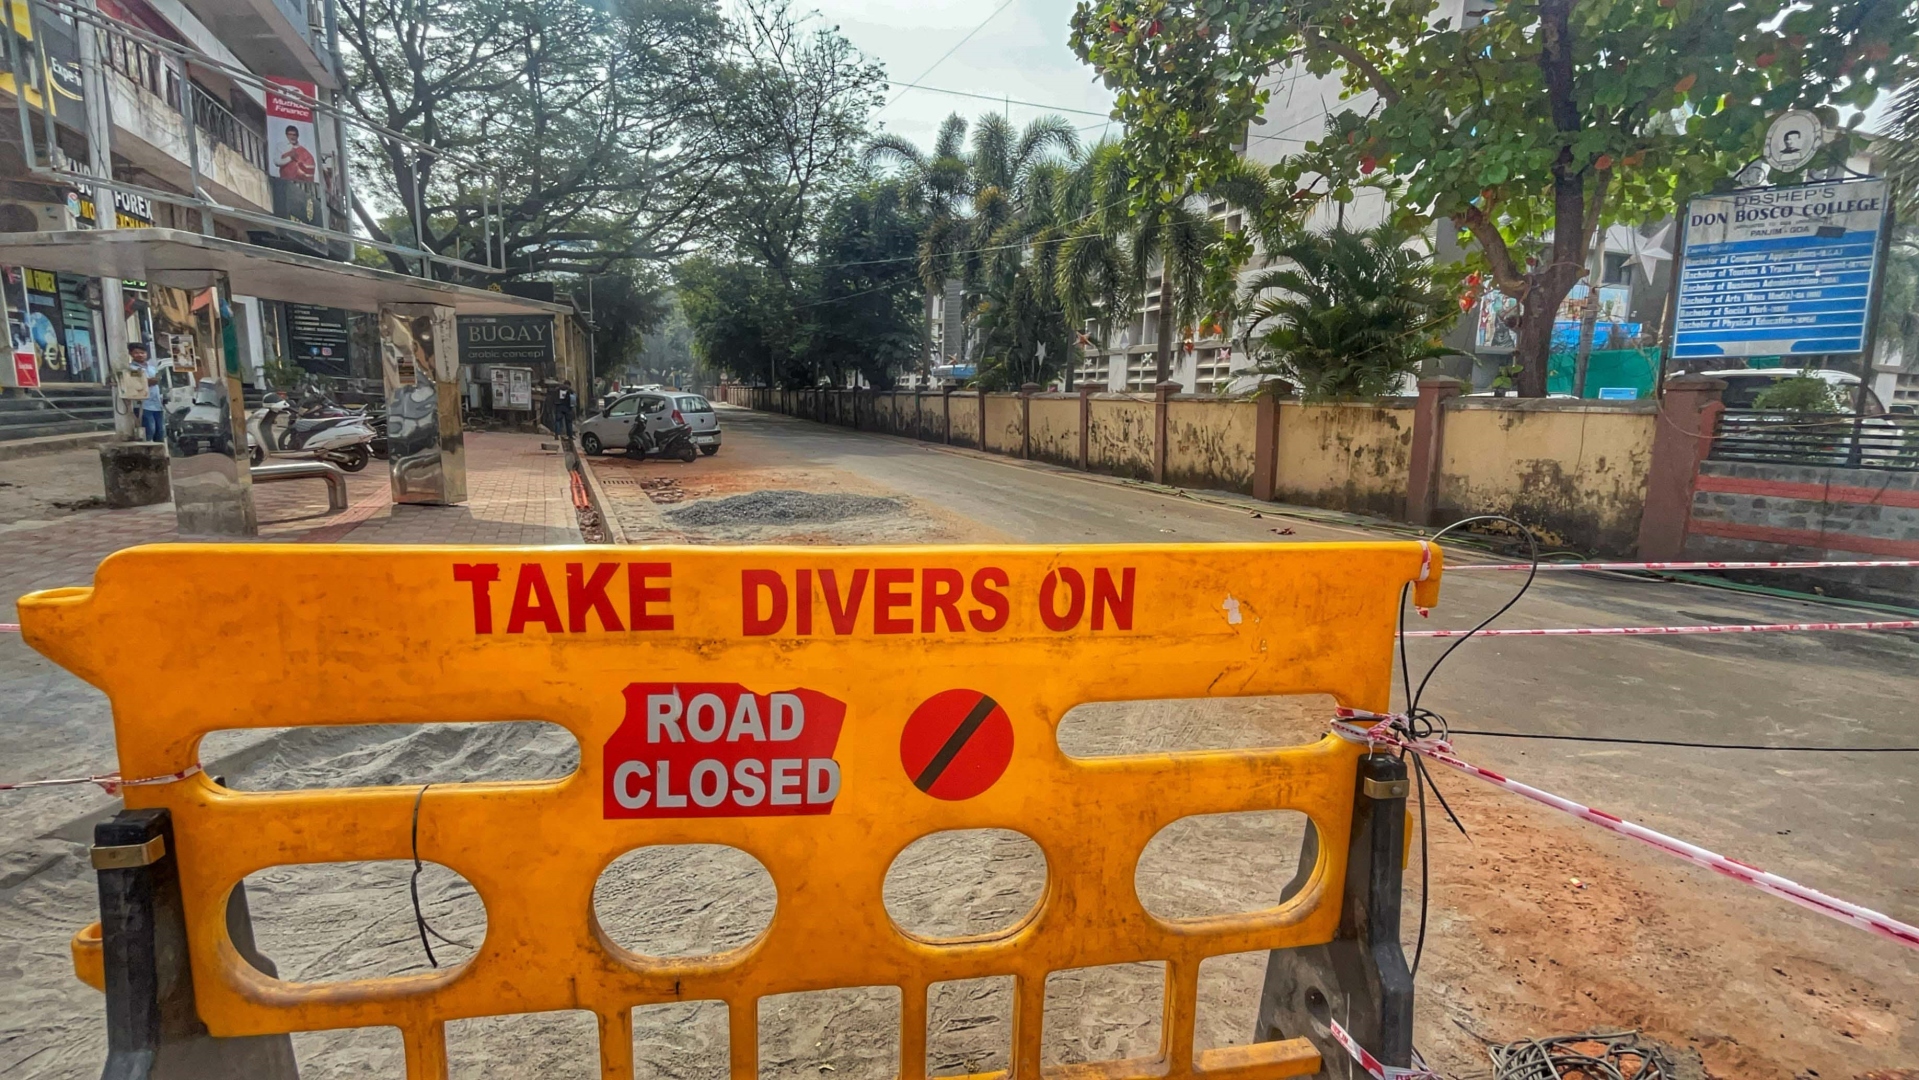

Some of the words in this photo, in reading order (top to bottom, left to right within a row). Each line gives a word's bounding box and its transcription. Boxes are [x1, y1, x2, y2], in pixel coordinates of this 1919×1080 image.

[275, 105, 310, 117] Finance
[1734, 187, 1836, 206] DBSHEP'S
[114, 191, 153, 220] FOREX
[1691, 211, 1727, 227] DON
[1734, 204, 1793, 223] BOSCO
[1802, 196, 1880, 217] COLLEGE
[1716, 281, 1724, 290] of
[1714, 295, 1722, 303] of
[1725, 293, 1741, 302] Arts
[1713, 307, 1721, 315] of
[1711, 319, 1719, 327] of
[468, 325, 546, 342] BUQAY
[468, 350, 500, 358] arabic
[503, 350, 544, 359] concept
[453, 562, 674, 634] TAKE
[647, 692, 805, 743] ROAD
[613, 758, 842, 809] CLOSED
